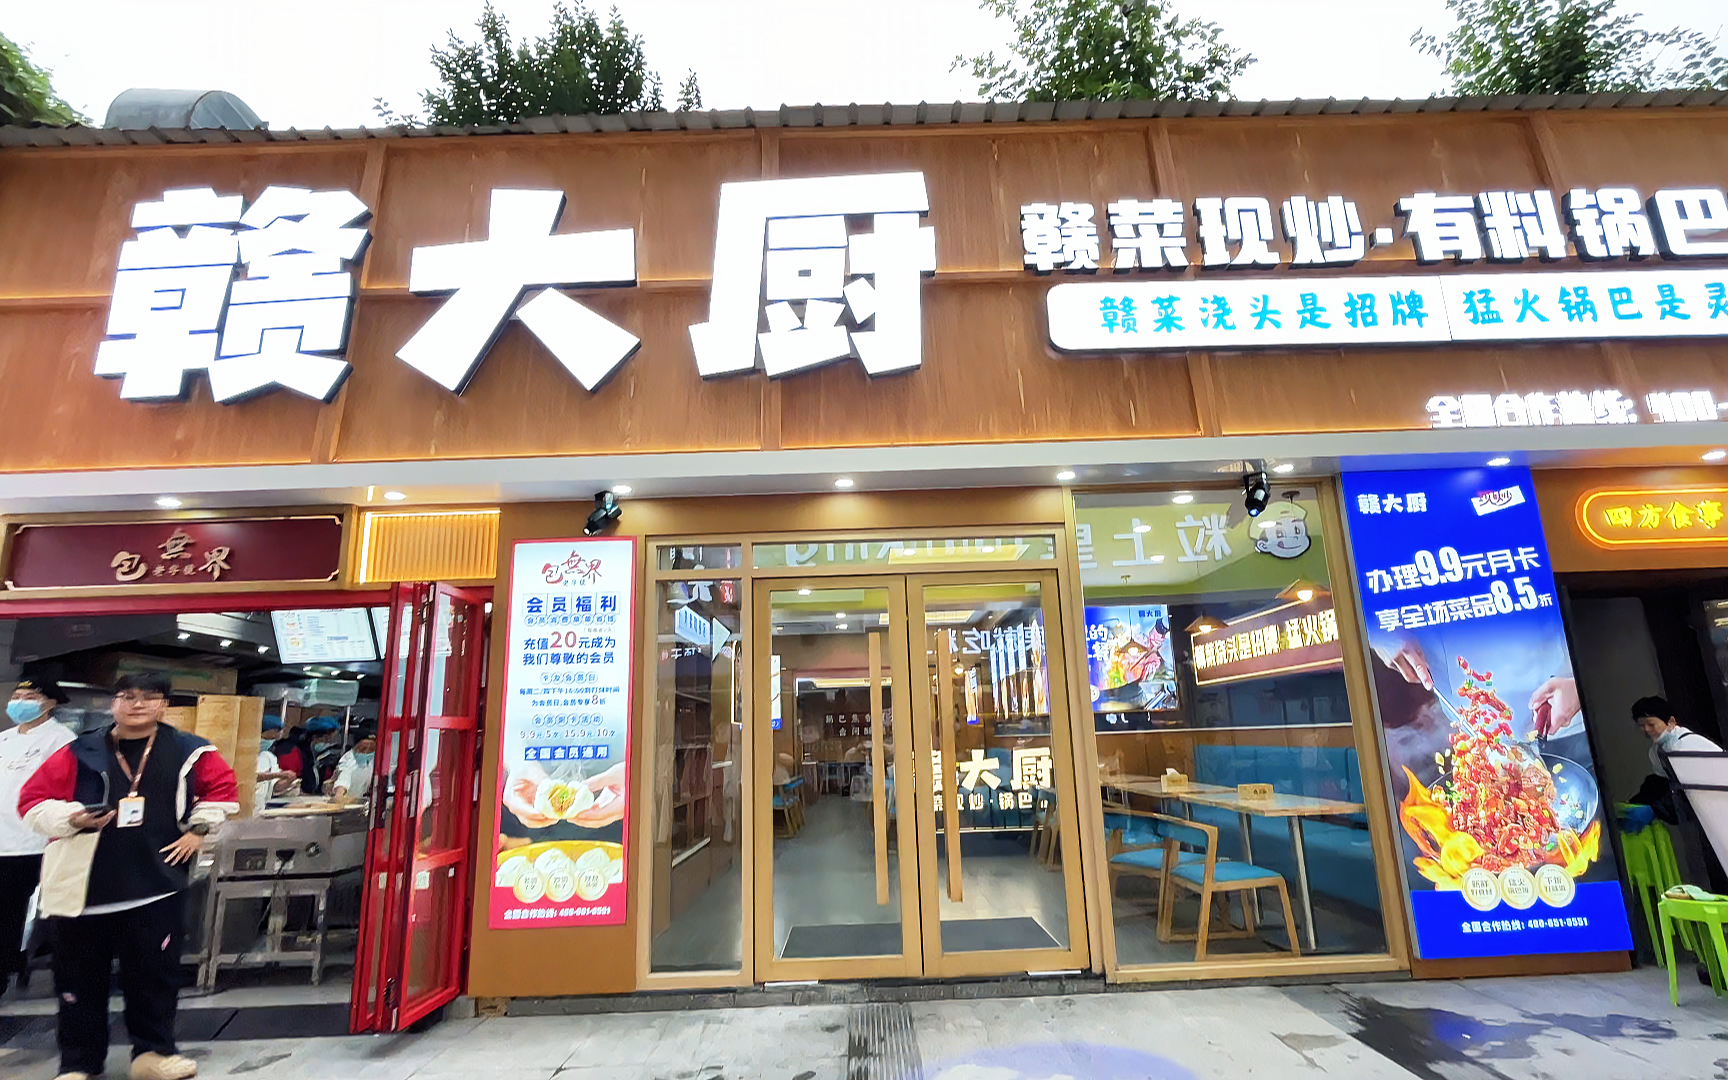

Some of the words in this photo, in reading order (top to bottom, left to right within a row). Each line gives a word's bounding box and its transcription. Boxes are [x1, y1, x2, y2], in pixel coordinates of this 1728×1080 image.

[94, 171, 936, 403] 赣大厨
[1100, 289, 1428, 334] 赣菜浇头是招牌
[1358, 492, 1427, 515] 赣大厨
[1604, 500, 1724, 530] 四方食事
[1366, 546, 1541, 594] 办理9.9元月卡
[527, 595, 616, 613] 会员福利
[1375, 577, 1552, 632] 享全场菜品8.5折
[523, 631, 616, 650] 充值20元成为
[523, 651, 614, 666] 我们尊敬的会员
